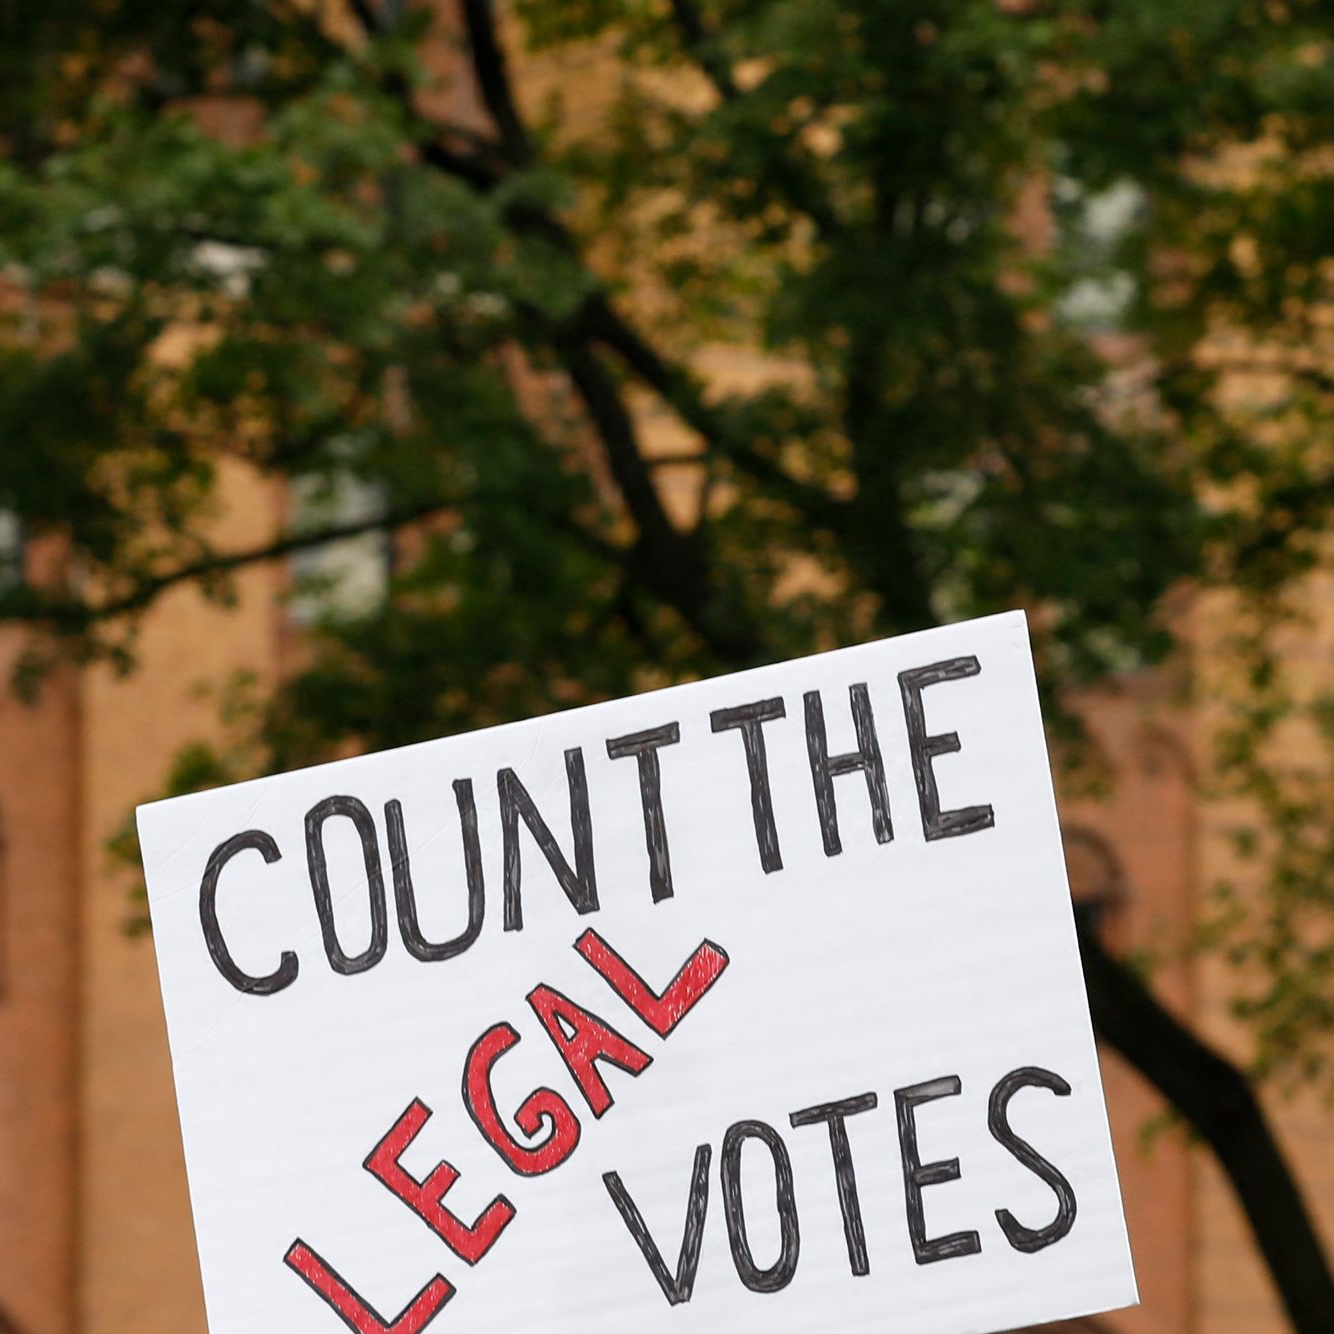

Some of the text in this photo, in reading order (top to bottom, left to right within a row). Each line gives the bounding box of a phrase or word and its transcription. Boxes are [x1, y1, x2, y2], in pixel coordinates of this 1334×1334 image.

[198, 655, 995, 997] COUNT THE
[601, 1066, 1078, 1307] VOTES
